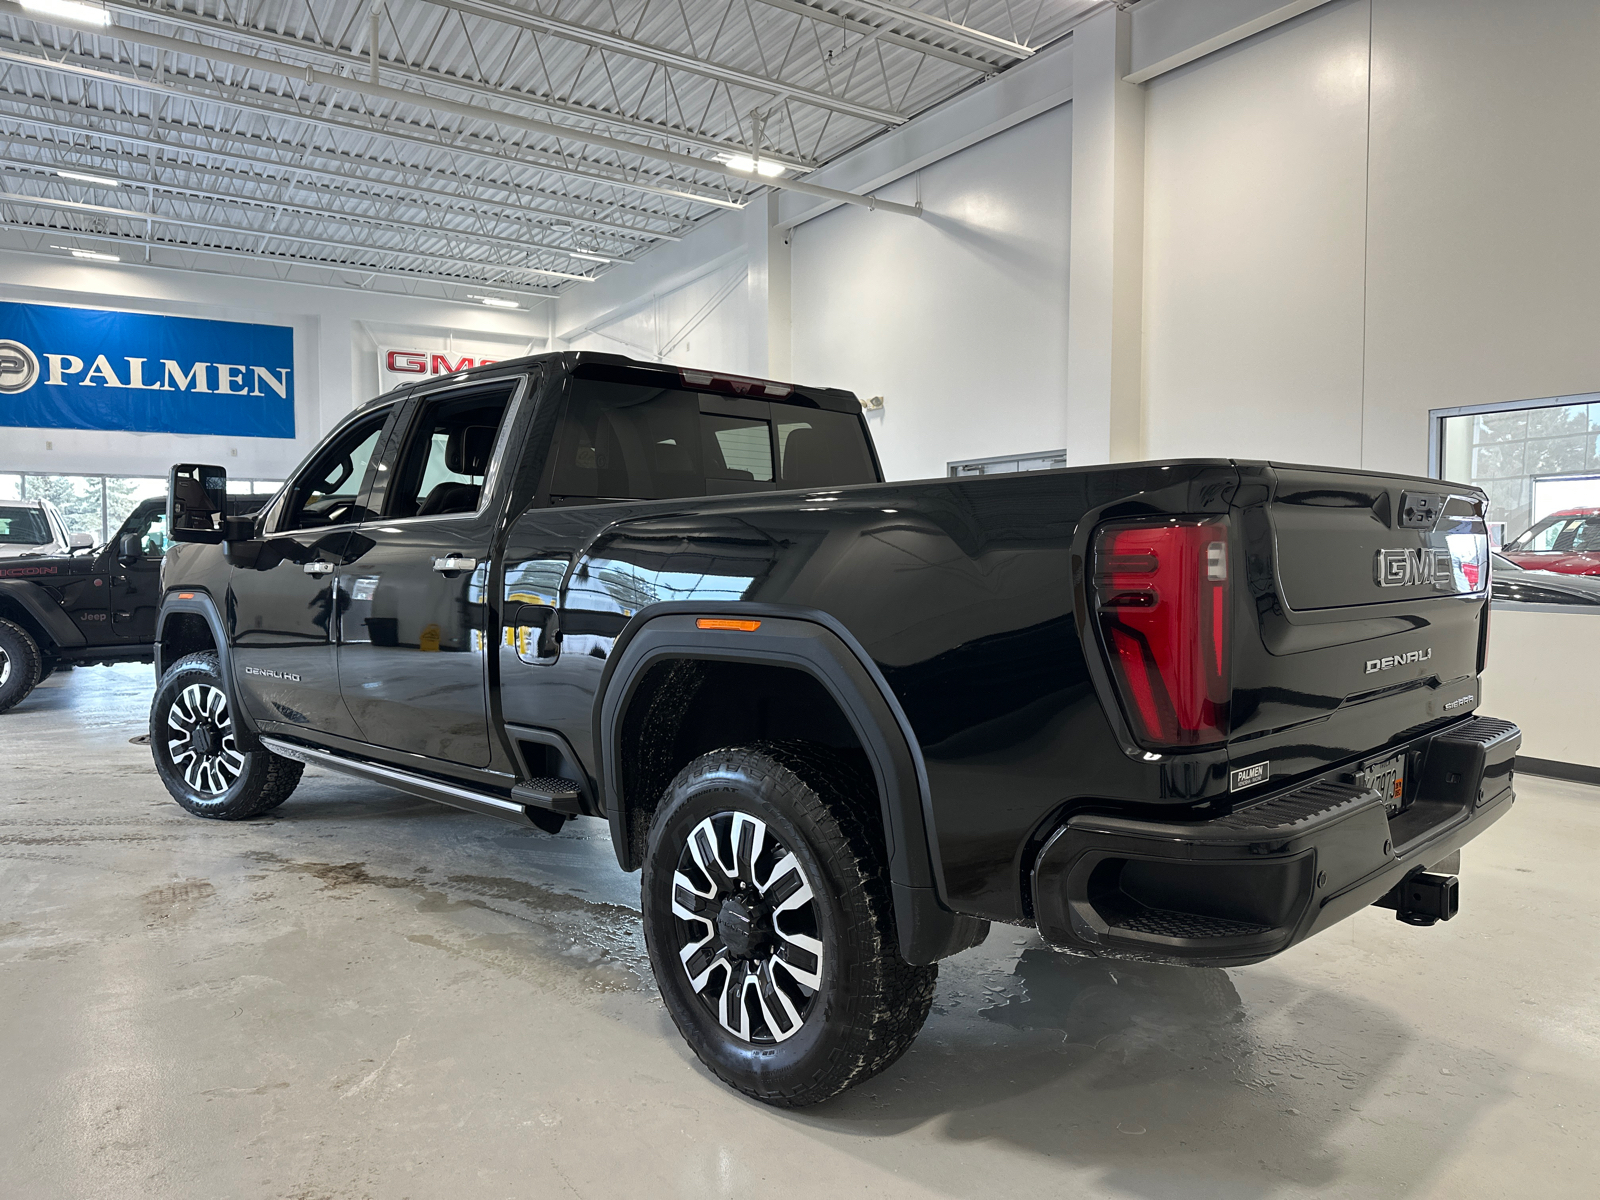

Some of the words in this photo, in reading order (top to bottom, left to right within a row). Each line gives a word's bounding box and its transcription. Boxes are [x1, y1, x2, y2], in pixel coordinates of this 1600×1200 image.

[43, 353, 291, 399] PALMEN
[1377, 547, 1451, 588] GMC
[80, 612, 107, 623] Jeep
[1365, 648, 1432, 675] DENALI
[246, 666, 284, 680] DENALI
[284, 671, 302, 683] HD
[1443, 694, 1474, 712] SIERRA
[1237, 765, 1263, 782] PALMEN
